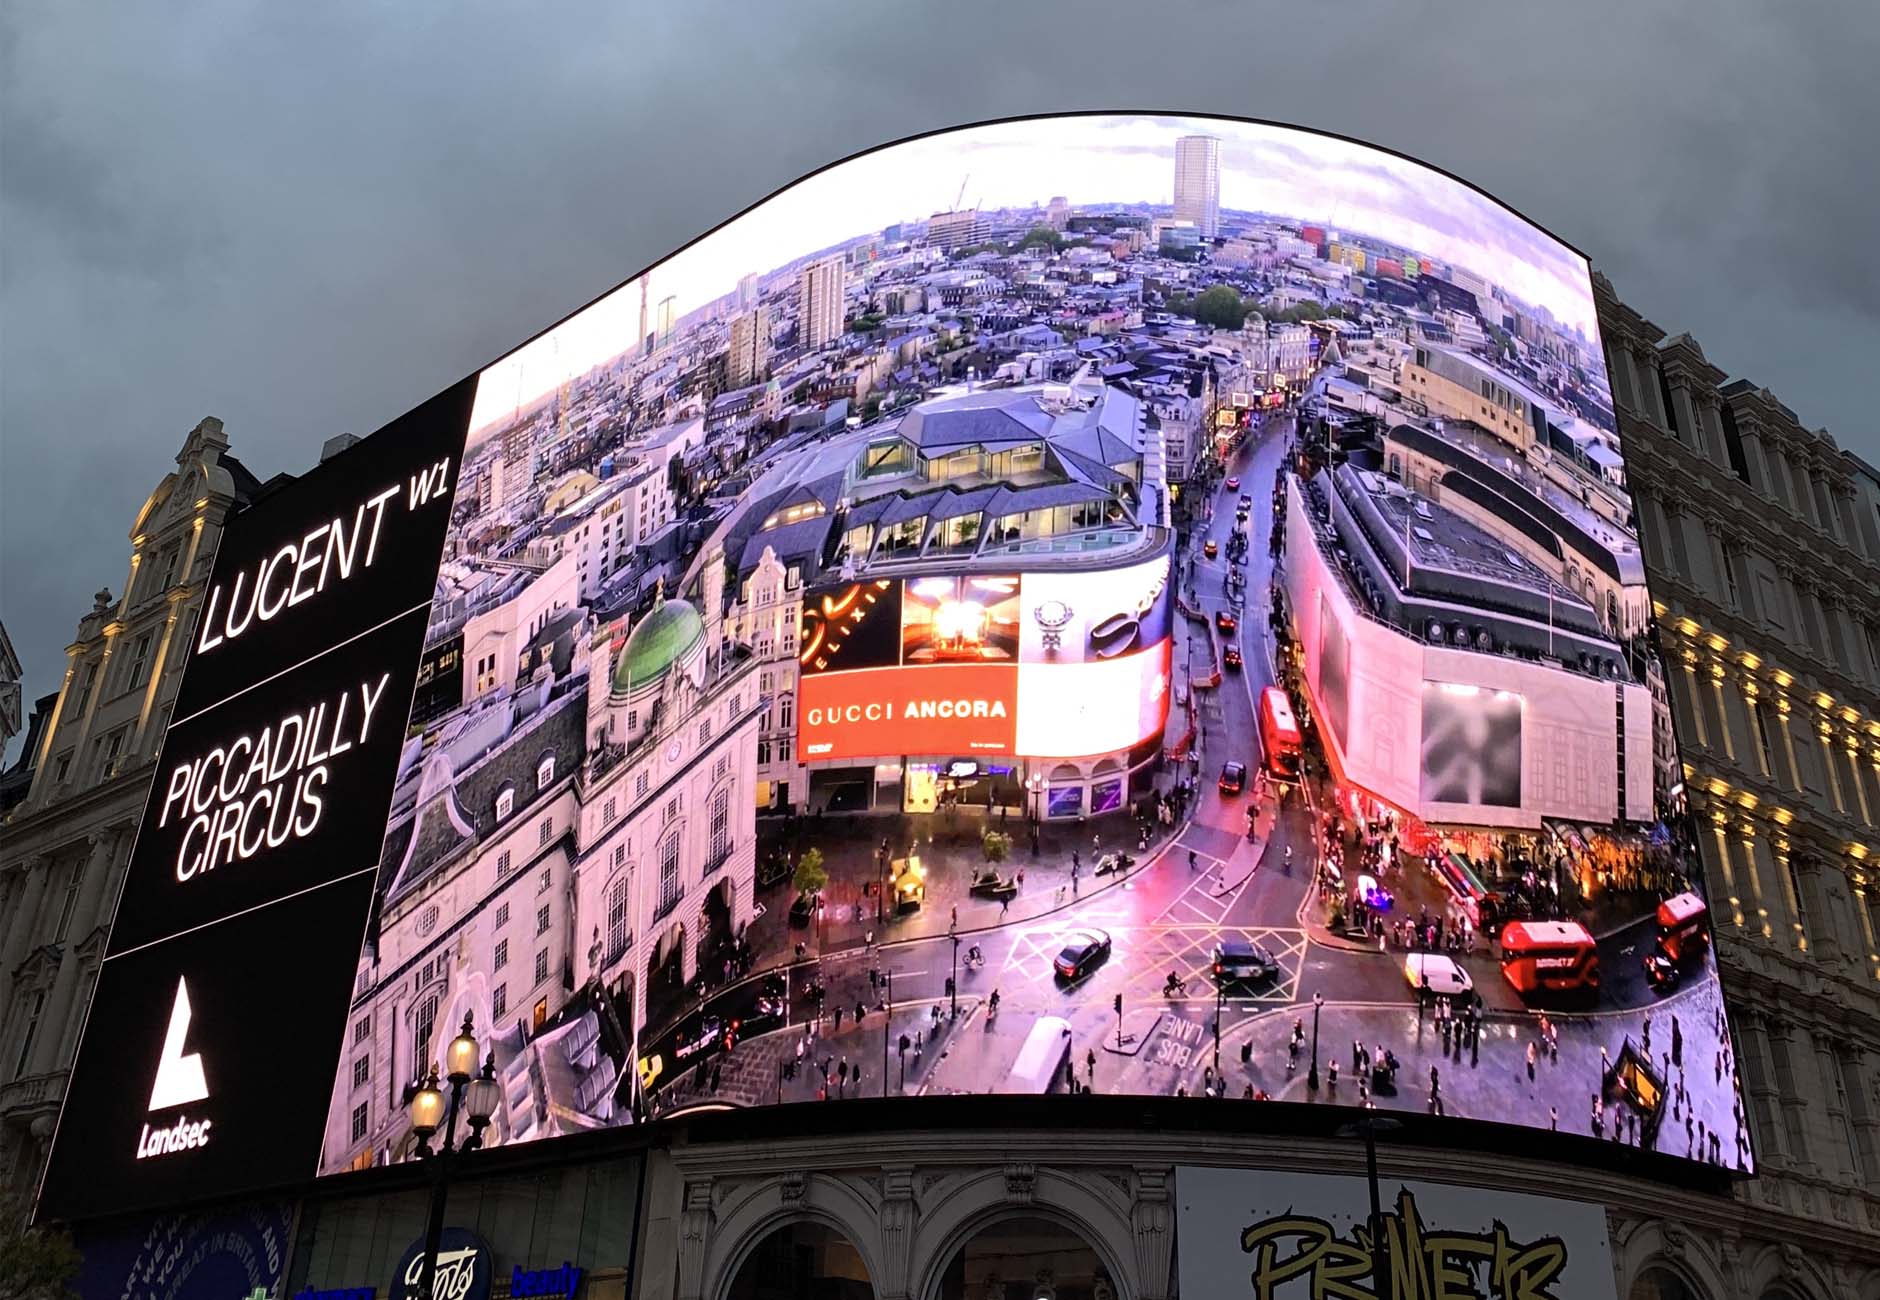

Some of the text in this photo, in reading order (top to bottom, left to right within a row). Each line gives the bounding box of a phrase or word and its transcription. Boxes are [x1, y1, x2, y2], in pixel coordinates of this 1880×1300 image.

[197, 456, 450, 655] LUCENT W1
[807, 699, 1007, 726] GUCCI ANCORA
[159, 673, 390, 828] PICCADILLY
[176, 765, 329, 883] CIRCUS
[1156, 1038, 1192, 1068] BUS
[1160, 1014, 1204, 1046] LANE
[136, 1114, 212, 1160] Landsec
